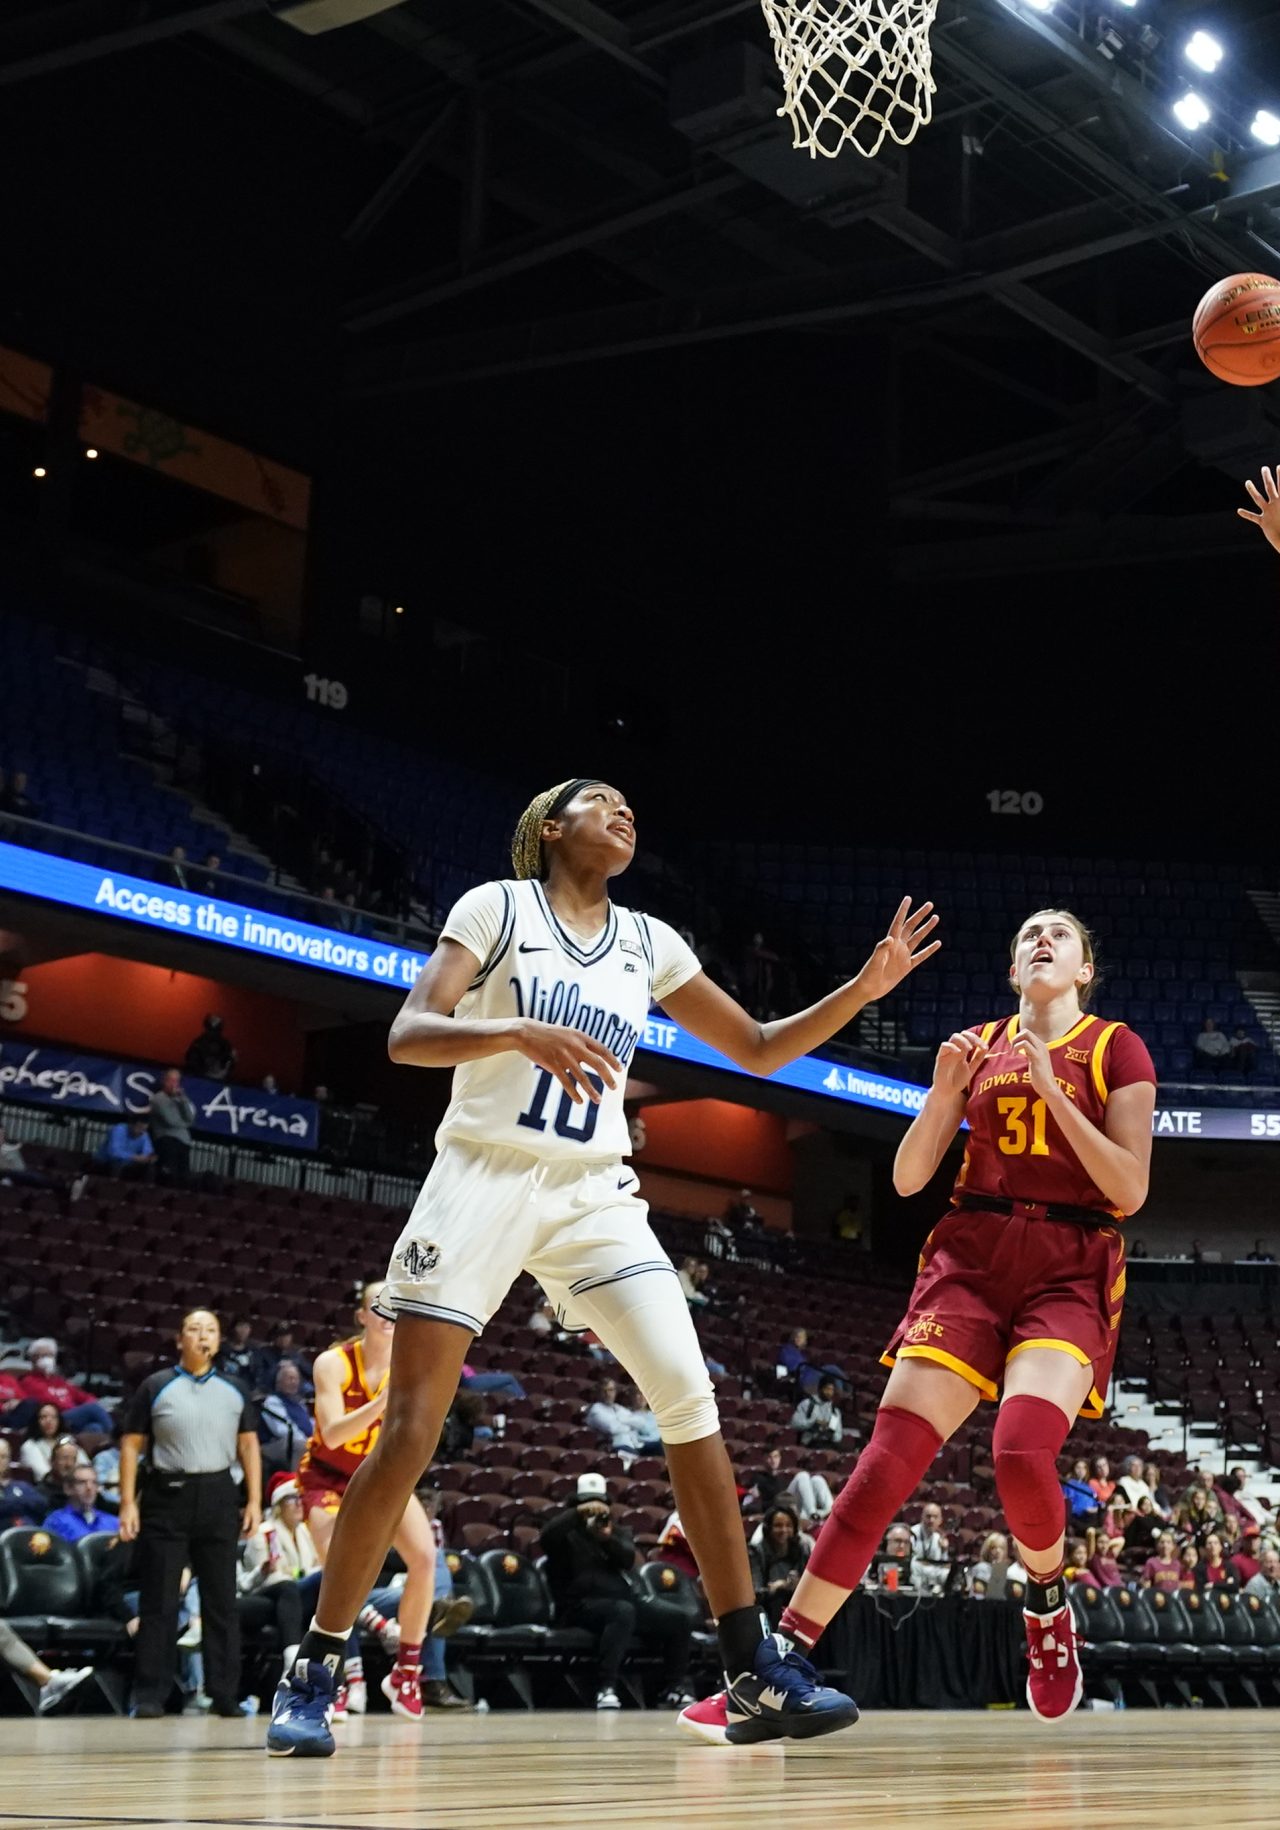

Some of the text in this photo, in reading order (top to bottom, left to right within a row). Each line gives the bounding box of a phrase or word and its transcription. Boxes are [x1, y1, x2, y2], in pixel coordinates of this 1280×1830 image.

[304, 673, 347, 709] 119
[986, 789, 1043, 815] 120
[95, 878, 191, 926] Access
[196, 904, 238, 938] the
[244, 914, 368, 971] innovators
[373, 953, 397, 977] of
[643, 1021, 677, 1049] ETF
[847, 1072, 902, 1105] Invesco
[979, 1072, 1018, 1095] IOWA
[202, 1087, 308, 1137] Arena
[516, 1063, 604, 1143] 10
[997, 1096, 1050, 1156] 31
